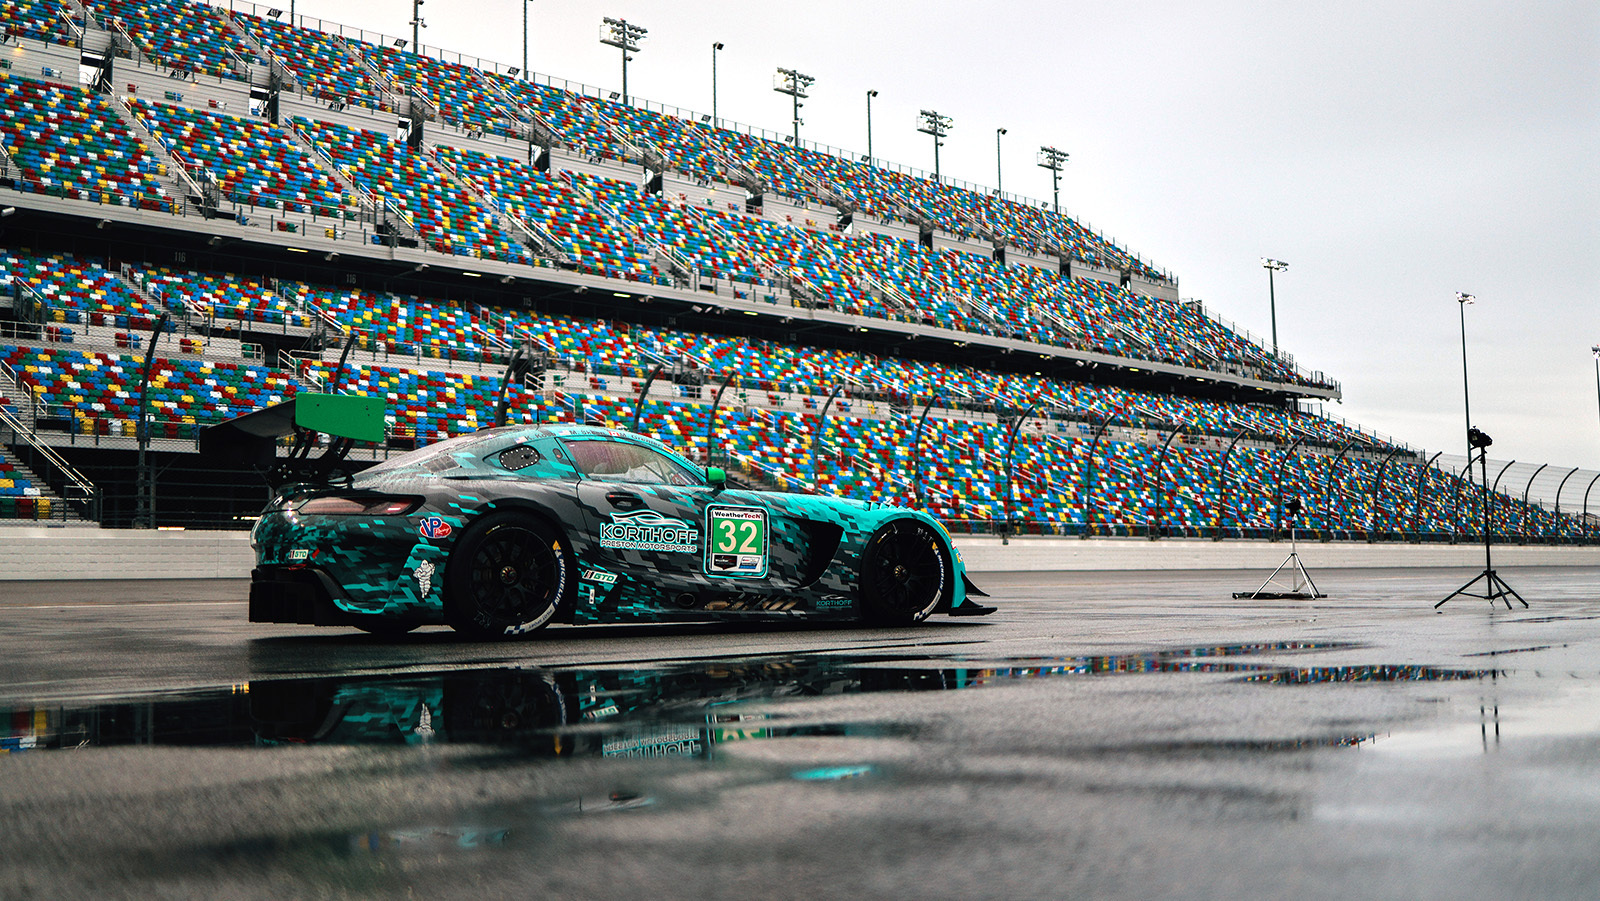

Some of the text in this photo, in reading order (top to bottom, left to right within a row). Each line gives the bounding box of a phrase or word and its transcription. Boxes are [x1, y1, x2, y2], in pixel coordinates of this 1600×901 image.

[174, 69, 185, 79] 318
[174, 251, 186, 263] 116
[420, 517, 442, 538] VP
[600, 523, 698, 545] KORTHOFF
[718, 520, 758, 553] 32
[600, 540, 698, 553] PRESTON MOTORSPORTS
[553, 558, 566, 605] MICHELIN
[593, 573, 615, 582] GTD
